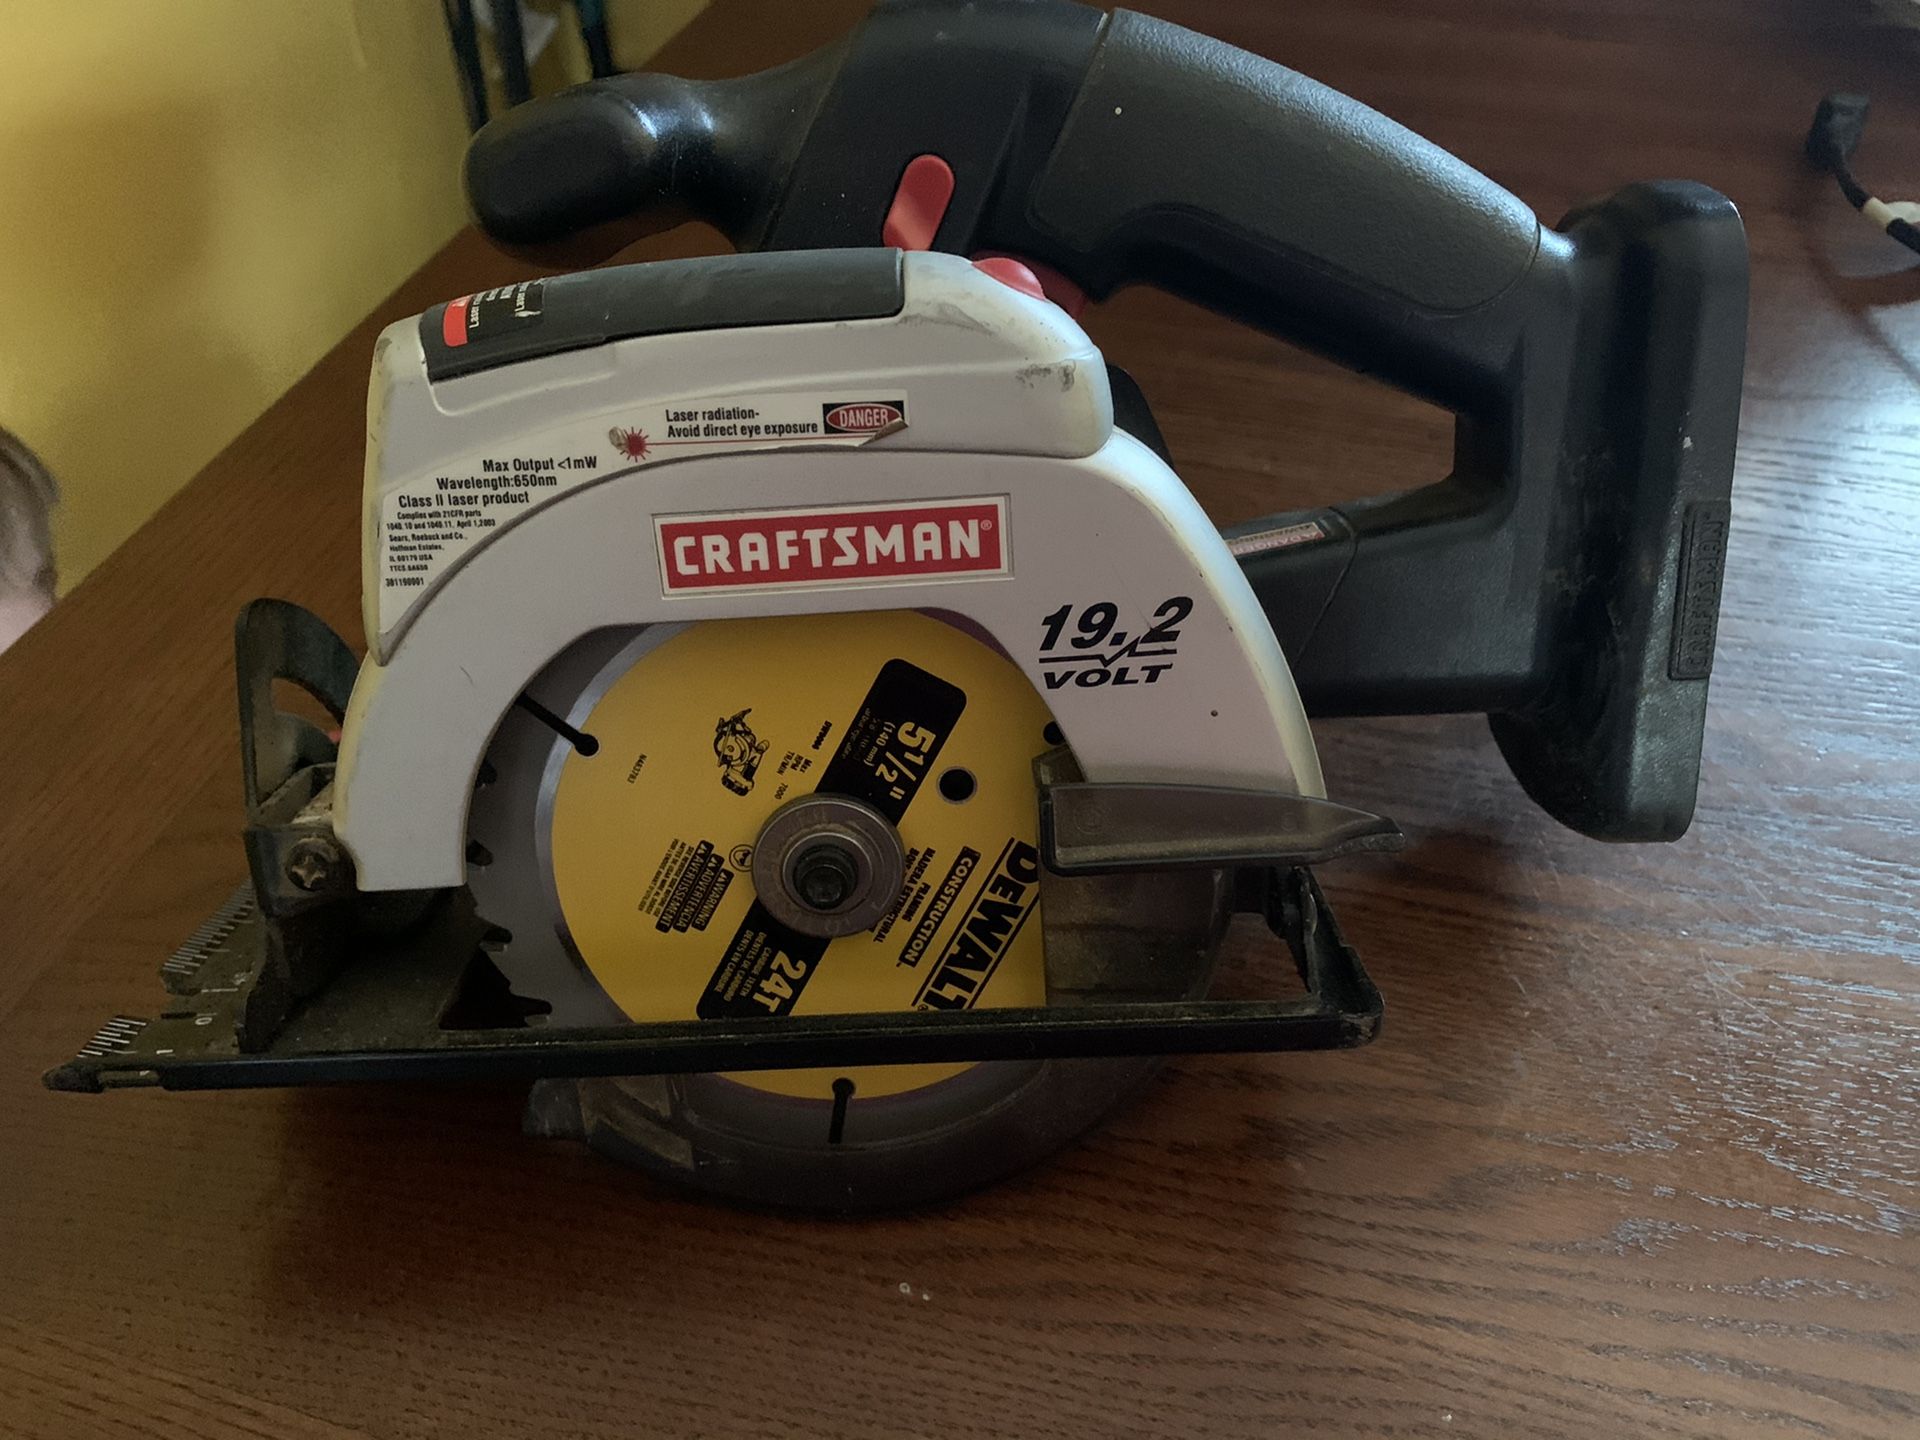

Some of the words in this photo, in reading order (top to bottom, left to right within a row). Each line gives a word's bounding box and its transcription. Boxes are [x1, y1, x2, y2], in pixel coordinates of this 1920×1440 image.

[665, 409, 699, 422] Laser
[702, 407, 760, 421] radiation-
[839, 408, 889, 428] DANGER
[667, 424, 700, 438] Avoid
[703, 423, 738, 437] direct
[740, 425, 762, 438] eye
[764, 422, 818, 437] exposure
[483, 459, 509, 473] Max
[513, 458, 554, 473] Output
[436, 474, 557, 491] Wavelength:650nm
[398, 495, 432, 508] Class
[435, 494, 444, 507] II
[448, 493, 479, 506] laser
[483, 491, 530, 507] product
[397, 511, 427, 520] Complies
[428, 510, 442, 519] with
[465, 509, 482, 519] parts
[414, 521, 426, 530] and
[457, 519, 471, 529] April
[411, 532, 440, 542] Roebuck
[441, 532, 453, 541] and
[419, 553, 433, 561] USA
[1039, 596, 1194, 651] 19.2
[1043, 663, 1173, 689] VOLT
[875, 721, 895, 745] (140
[774, 783, 788, 799] 7000
[907, 847, 935, 884] MADERA
[660, 854, 703, 926] AVERTISSEMENT
[676, 868, 714, 926] ADVERTENCIA
[695, 880, 724, 925] WARNING
[901, 882, 930, 921] FRAMING
[905, 857, 972, 961] CONSTRUCTION
[873, 884, 913, 942] ESTRUCTURAL
[736, 929, 753, 951] DENTS
[753, 951, 805, 1011] 24T
